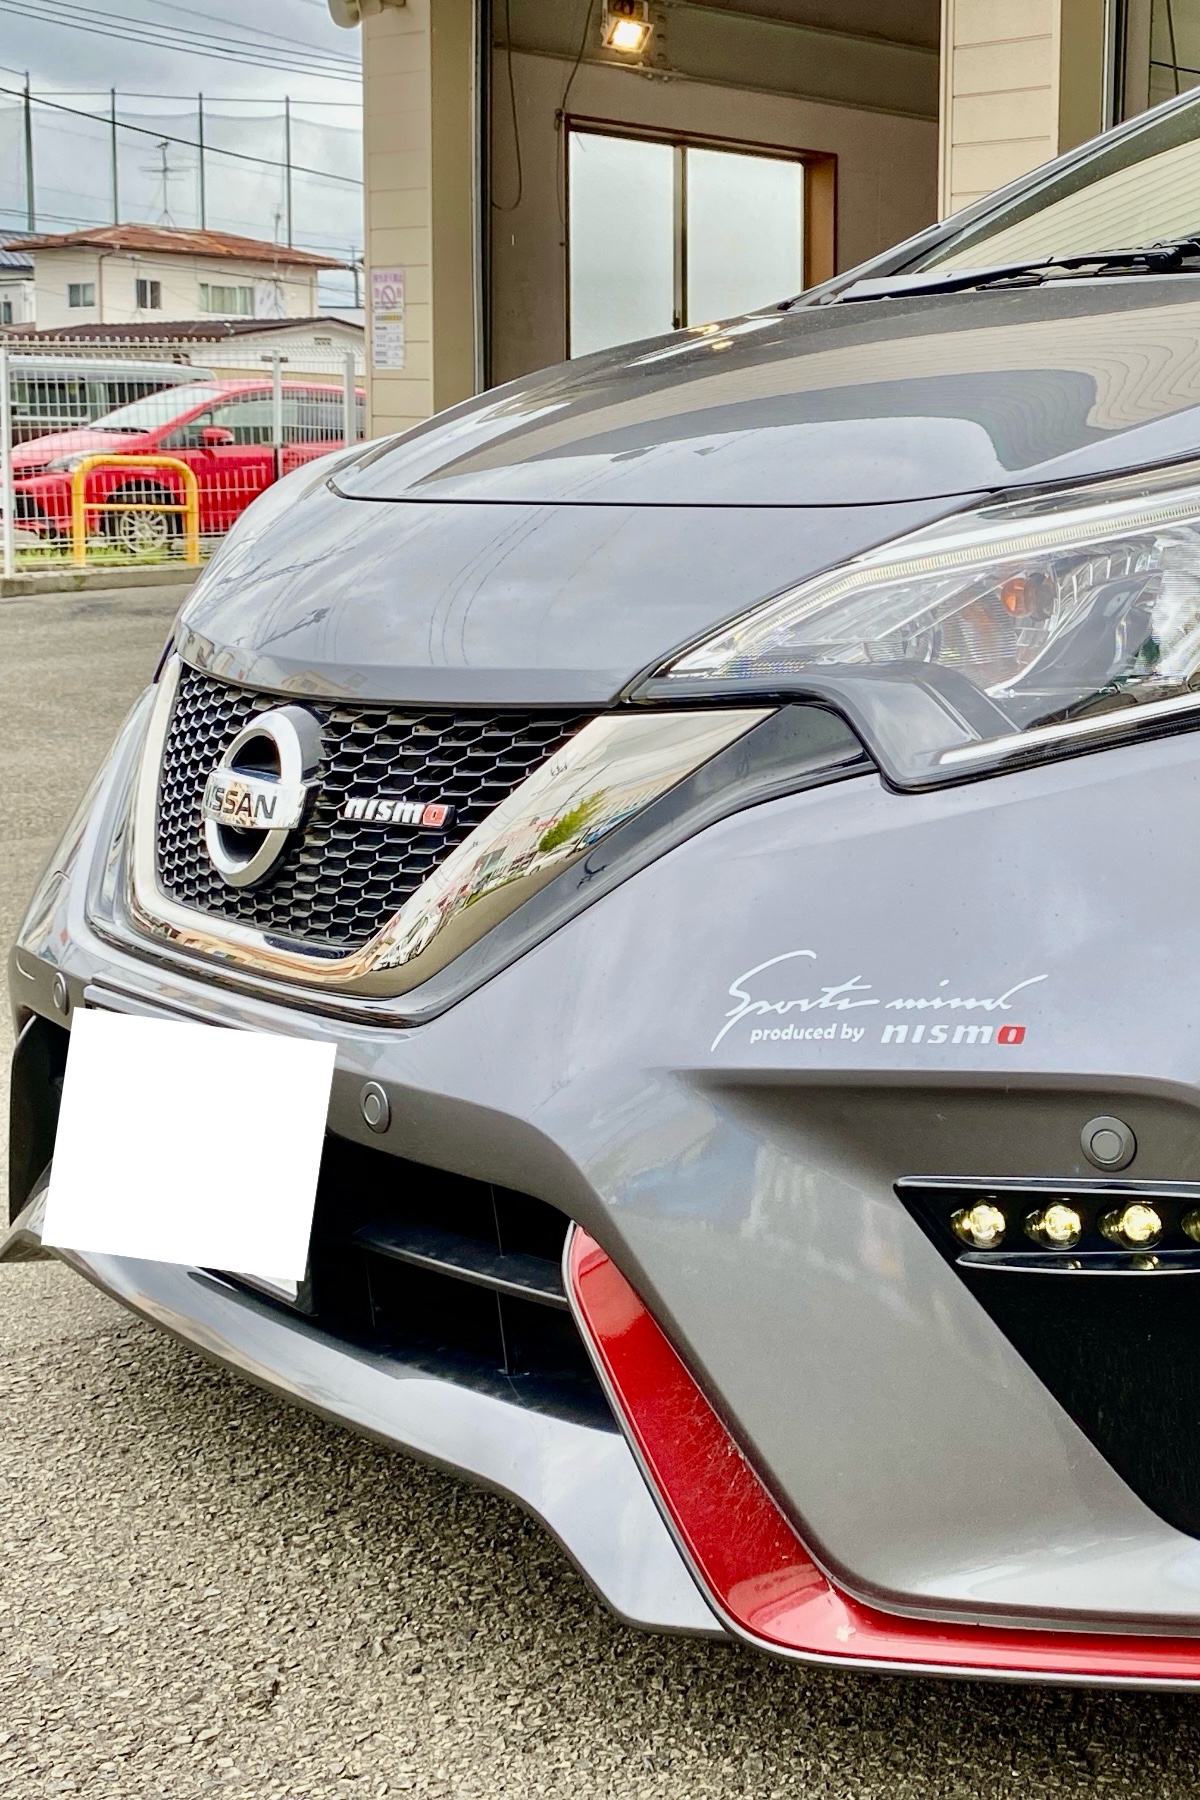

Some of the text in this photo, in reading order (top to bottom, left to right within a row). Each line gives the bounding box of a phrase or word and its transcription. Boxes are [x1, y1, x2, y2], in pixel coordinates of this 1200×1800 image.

[711, 950, 1049, 1052] Sports mind
[750, 1023, 865, 1044] produced by
